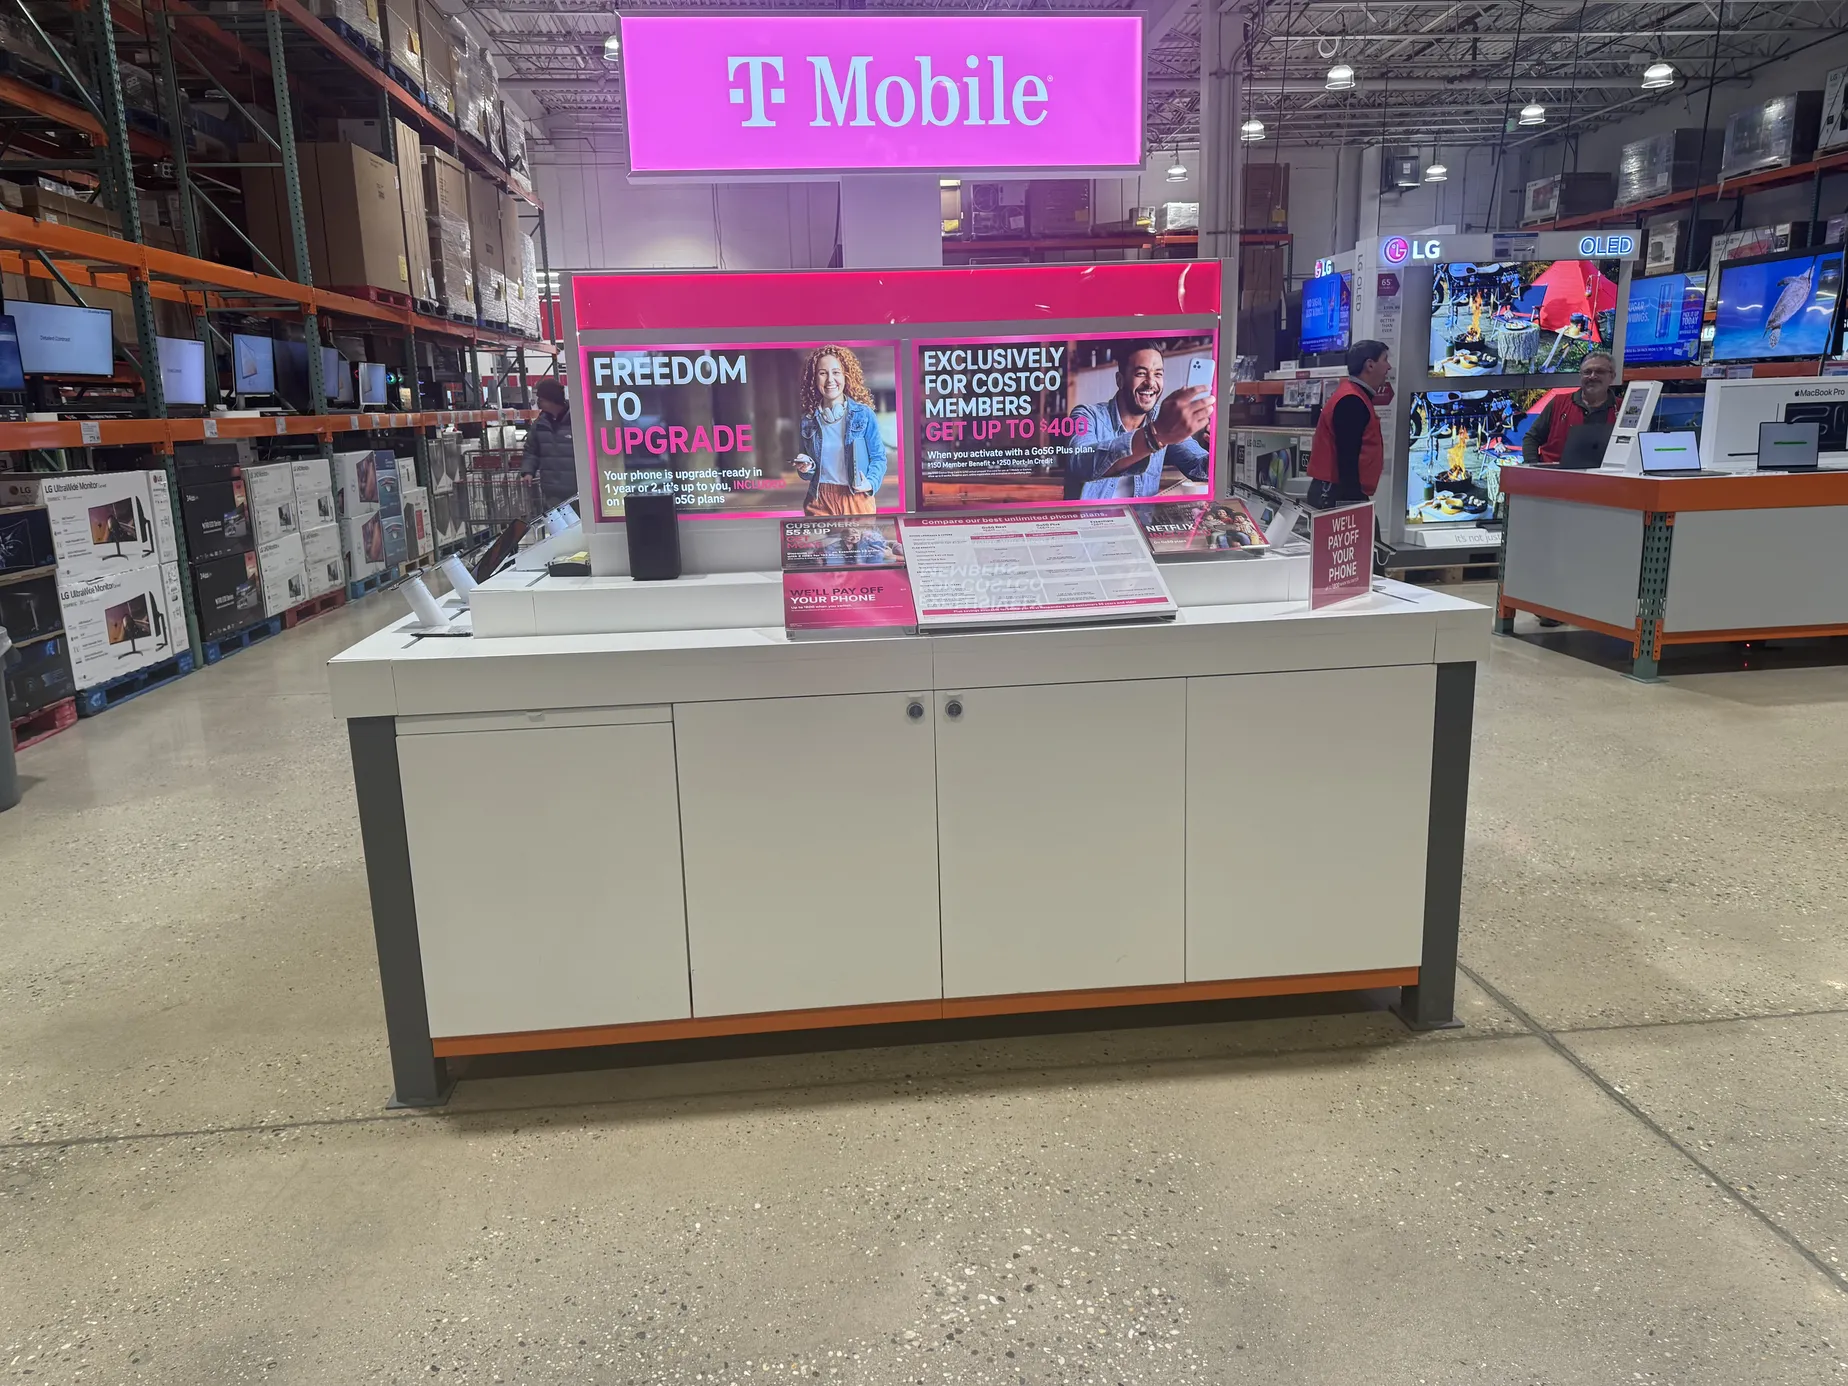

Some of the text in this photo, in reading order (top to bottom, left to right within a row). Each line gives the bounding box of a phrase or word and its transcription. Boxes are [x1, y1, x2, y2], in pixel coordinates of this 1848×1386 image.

[806, 54, 1049, 127] Mobile
[1412, 240, 1440, 259] LG
[1580, 236, 1633, 256] OLED
[1321, 260, 1332, 277] LG
[924, 347, 1065, 371] EXCLUSIVELY
[593, 355, 747, 386] FREEDOM
[925, 370, 1061, 395] FOR COSTCO
[596, 391, 642, 421] TO
[925, 395, 1032, 418] MEMBERS
[926, 416, 1088, 442] GET UP TO $400
[600, 424, 754, 456] UPGRADE
[927, 450, 952, 460] When
[953, 450, 968, 461] you
[970, 448, 1003, 458] activate
[1005, 448, 1023, 457] with
[1031, 446, 1055, 456] Go5G
[1056, 446, 1073, 455] Plus
[1074, 445, 1095, 455] plan.
[604, 466, 762, 482] Your phone is upgrade-ready in
[927, 462, 941, 470] $150
[942, 460, 967, 468] Member
[969, 459, 990, 467] Benefit
[44, 485, 53, 493] LG
[80, 481, 98, 490] Monitor
[605, 484, 610, 493] 1
[612, 484, 635, 496] year
[638, 484, 648, 492] or
[651, 482, 661, 494] 2,
[663, 482, 679, 492] it's
[681, 482, 694, 495] up
[696, 482, 707, 491] to
[710, 482, 732, 492] you,
[607, 498, 620, 507] on
[675, 495, 695, 505] o5G
[698, 495, 725, 507] plans
[1146, 524, 1196, 532] NETFLIX
[1332, 514, 1356, 532] WE'LL
[1328, 529, 1359, 550] PAY OFF
[1454, 534, 1500, 544] It's not just
[1332, 546, 1354, 565] YOUR
[1329, 562, 1357, 582] PHONE
[61, 592, 69, 600] LG
